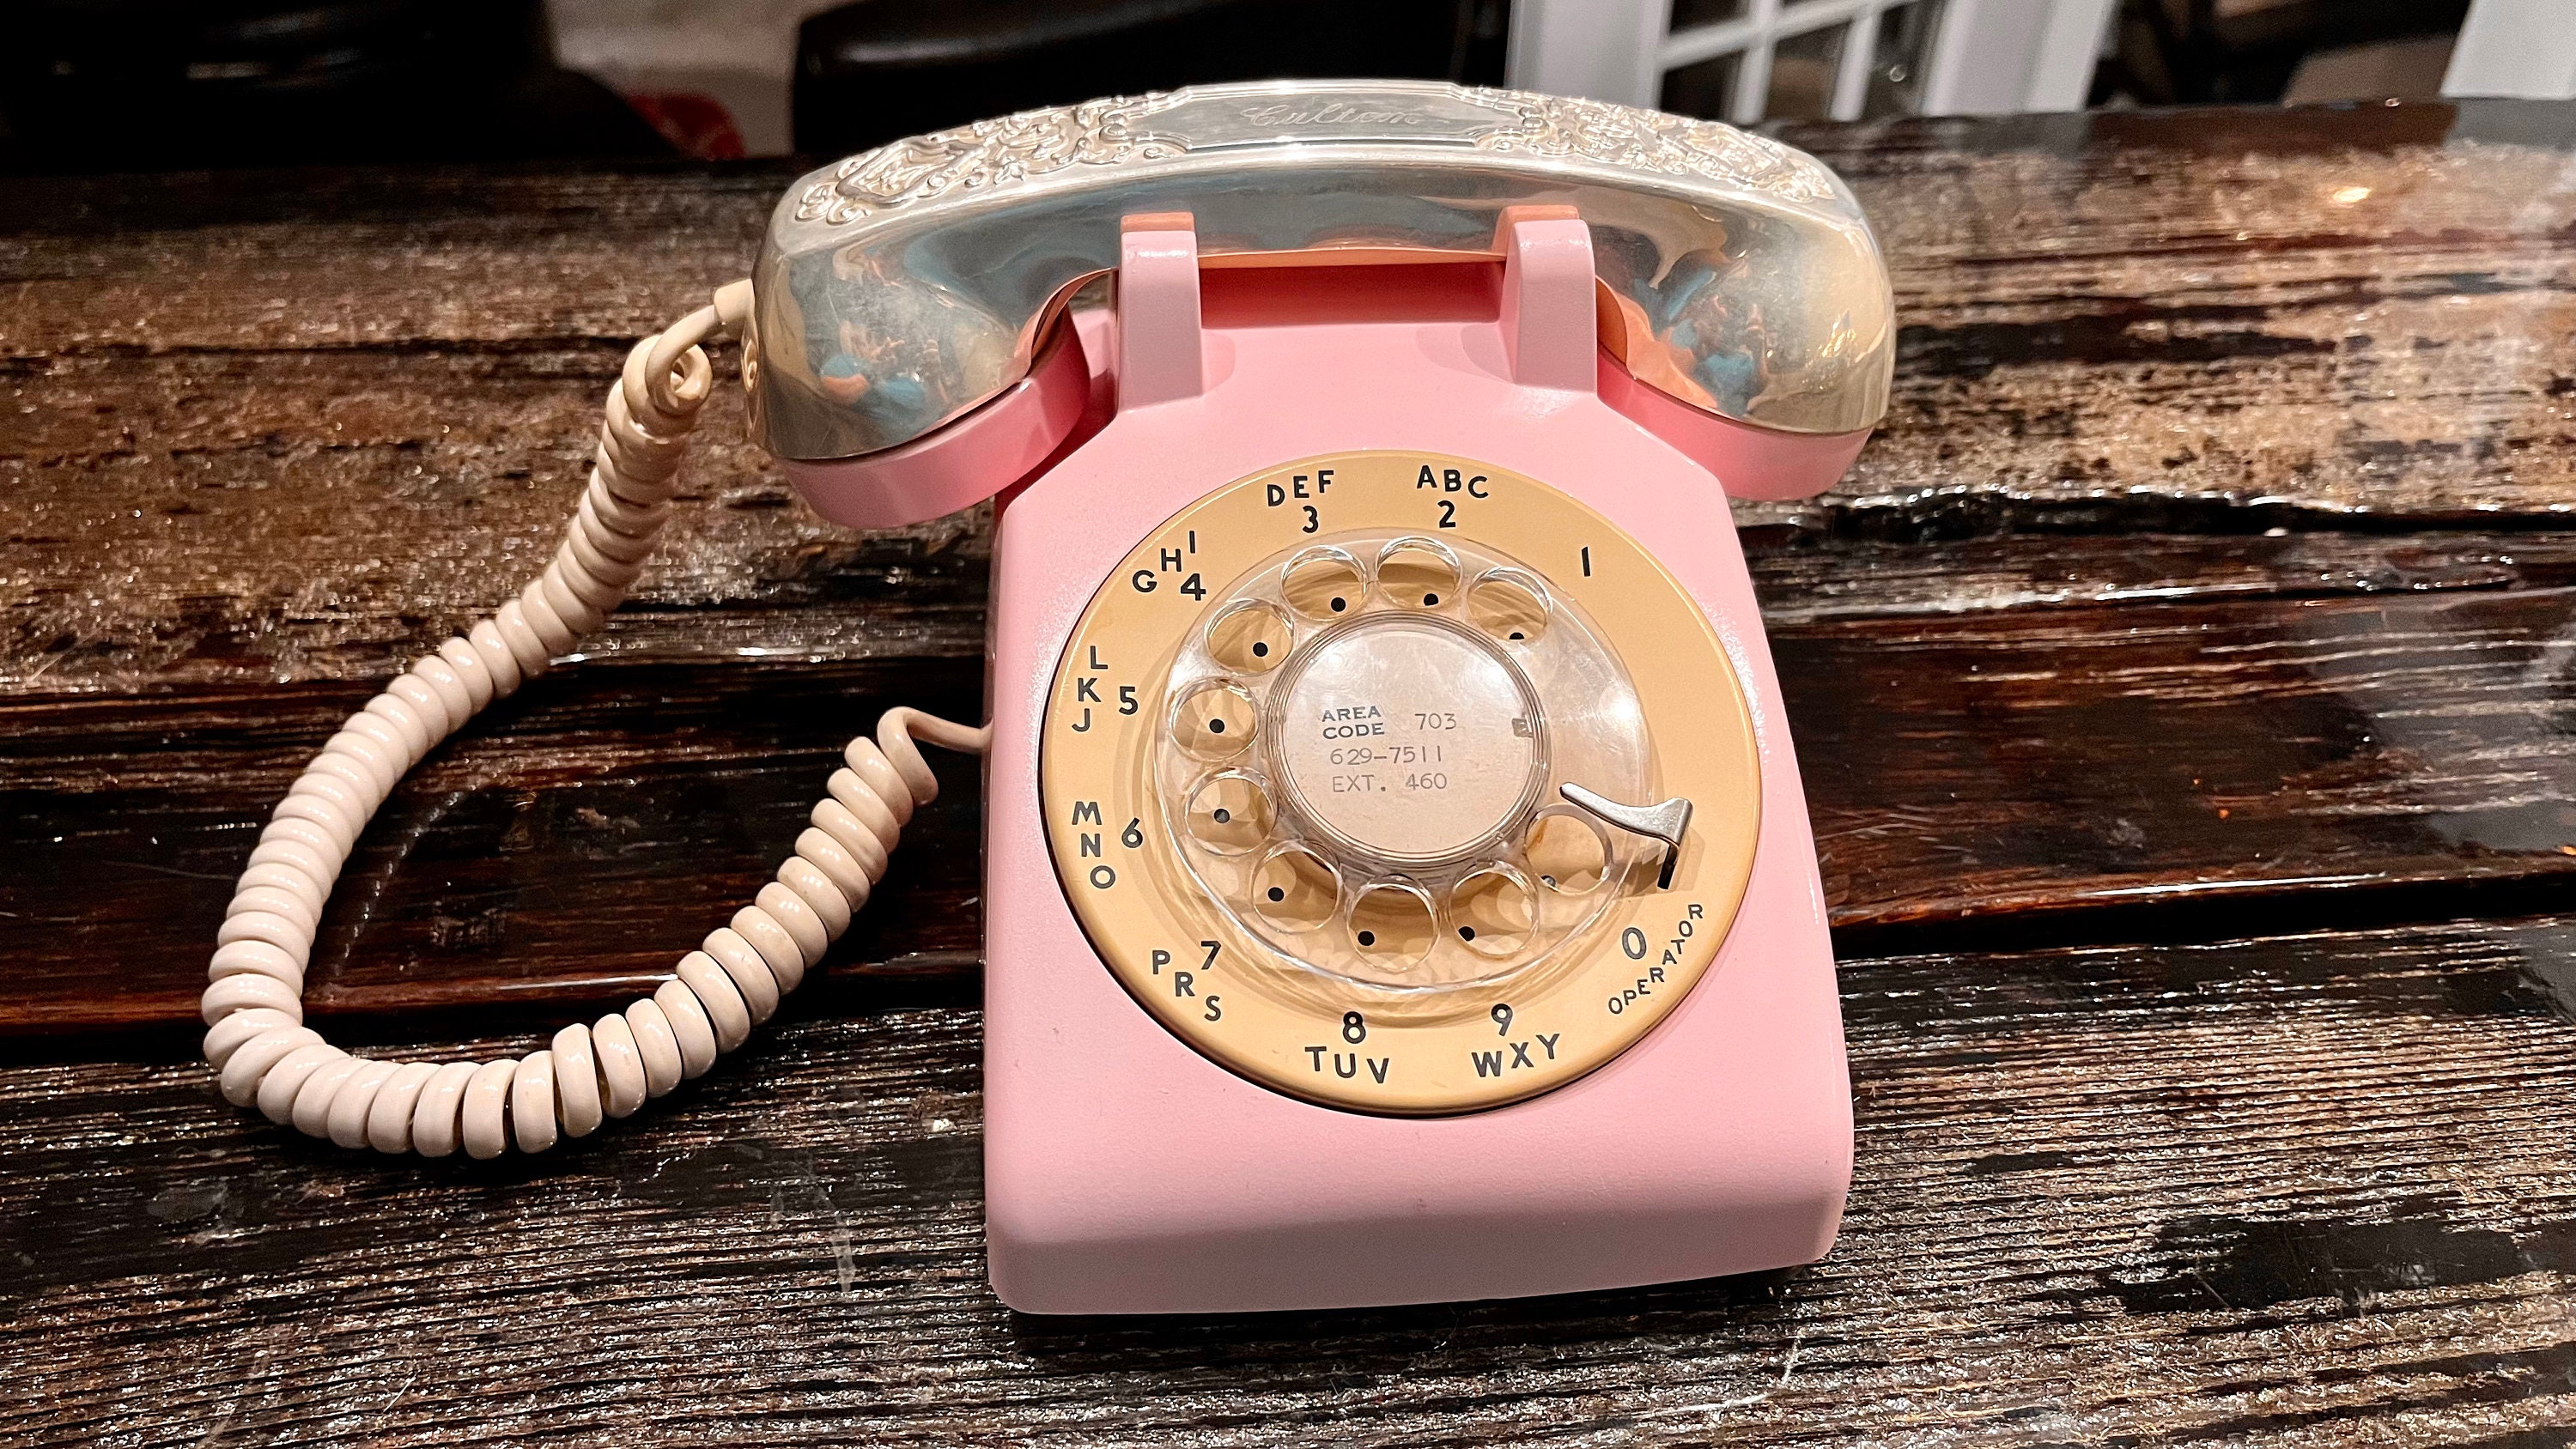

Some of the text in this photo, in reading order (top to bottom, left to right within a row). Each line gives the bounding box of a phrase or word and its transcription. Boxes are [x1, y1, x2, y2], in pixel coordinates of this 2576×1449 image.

[1267, 470, 1334, 506] DEF
[1416, 464, 1489, 499] ABC
[1302, 505, 1319, 534] 3
[1437, 500, 1456, 529] 2
[1132, 530, 1196, 593] GHI
[1180, 573, 1206, 601] 4
[1118, 686, 1139, 715] 5
[1321, 706, 1382, 723] AREA
[1322, 722, 1385, 740] CODE
[1414, 712, 1457, 731] 703
[1330, 745, 1443, 766] 629-7511
[1332, 773, 1448, 793] EXT. 460
[1121, 817, 1143, 849] 6
[1200, 940, 1222, 970] 7
[1607, 903, 1704, 1015] OPERATOR
[1151, 949, 1221, 1022] PRS
[1342, 1010, 1367, 1045] 8
[1491, 1003, 1514, 1036] 9
[1304, 1046, 1390, 1084] TUV
[1471, 1033, 1561, 1078] WXY
